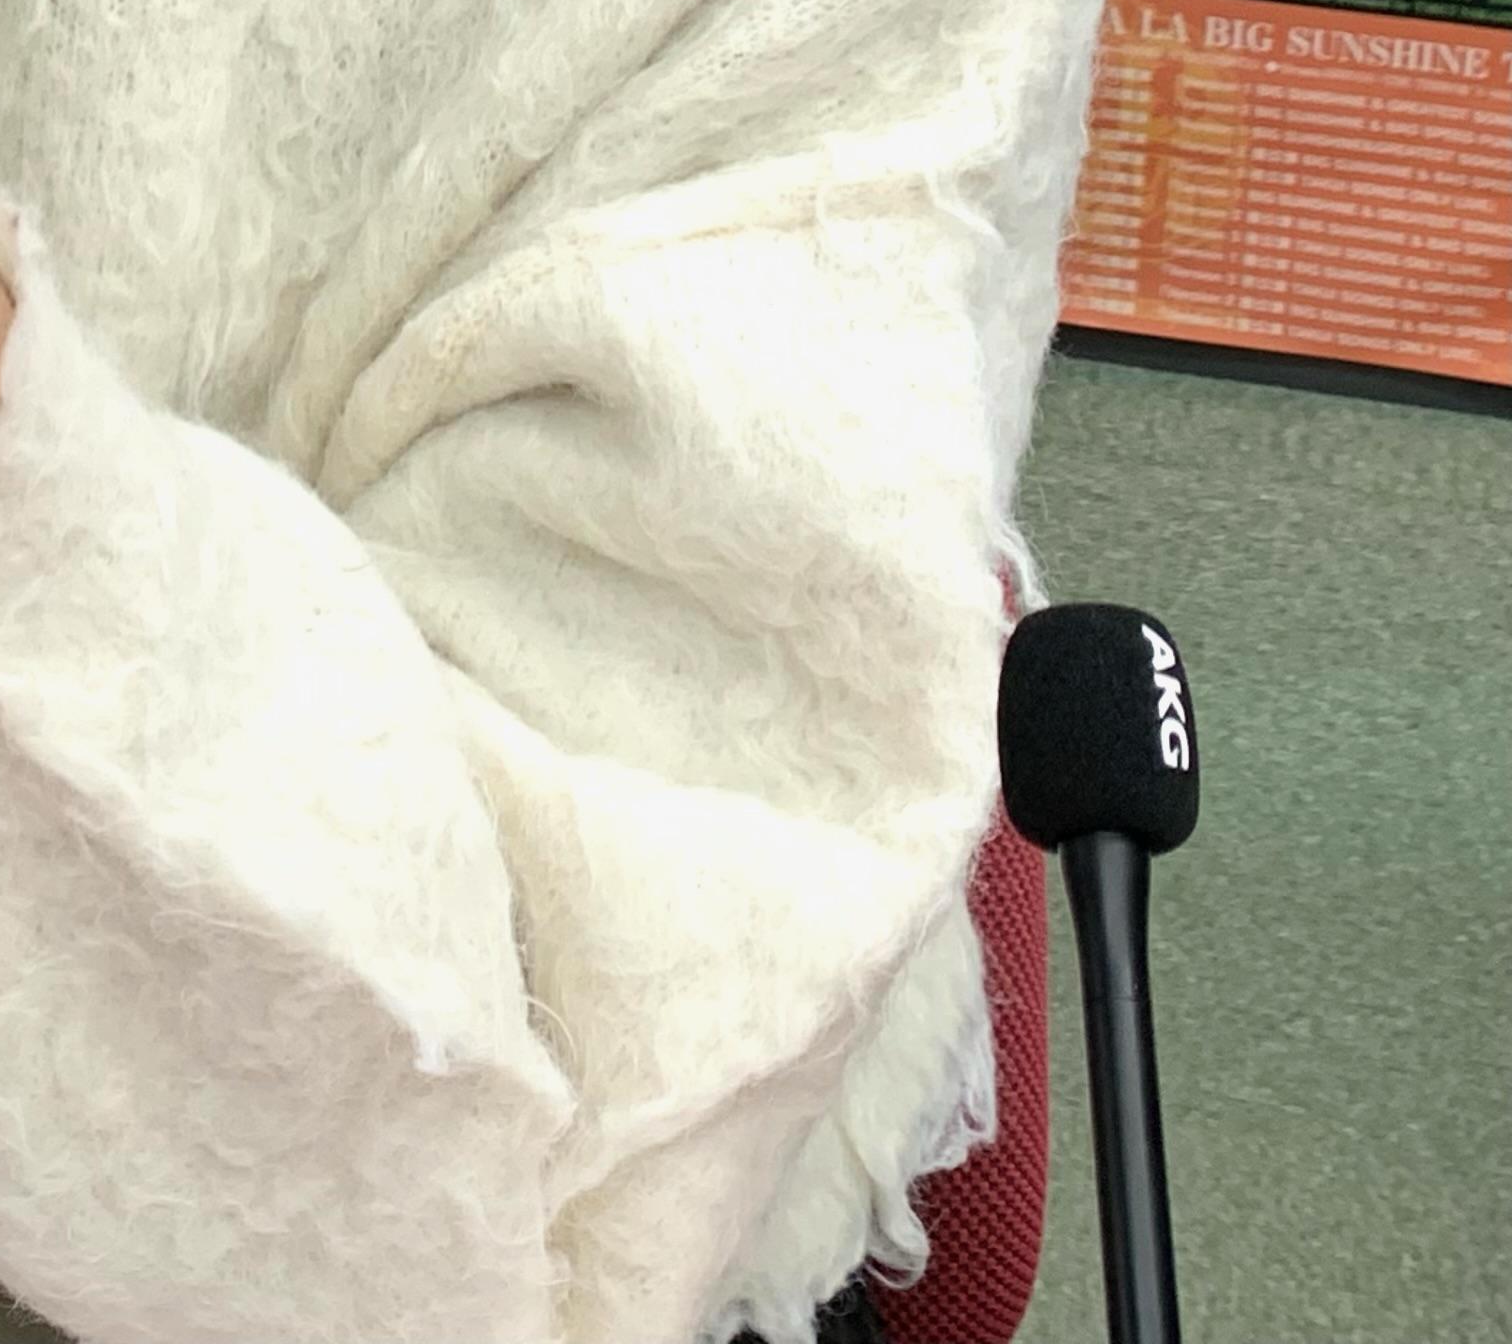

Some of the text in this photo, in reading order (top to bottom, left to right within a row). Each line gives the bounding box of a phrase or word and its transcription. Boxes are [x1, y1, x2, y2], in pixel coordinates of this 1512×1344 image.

[1204, 15, 1275, 54] BIG
[1287, 25, 1492, 80] SUNSHINE
[1141, 623, 1190, 772] AKG
